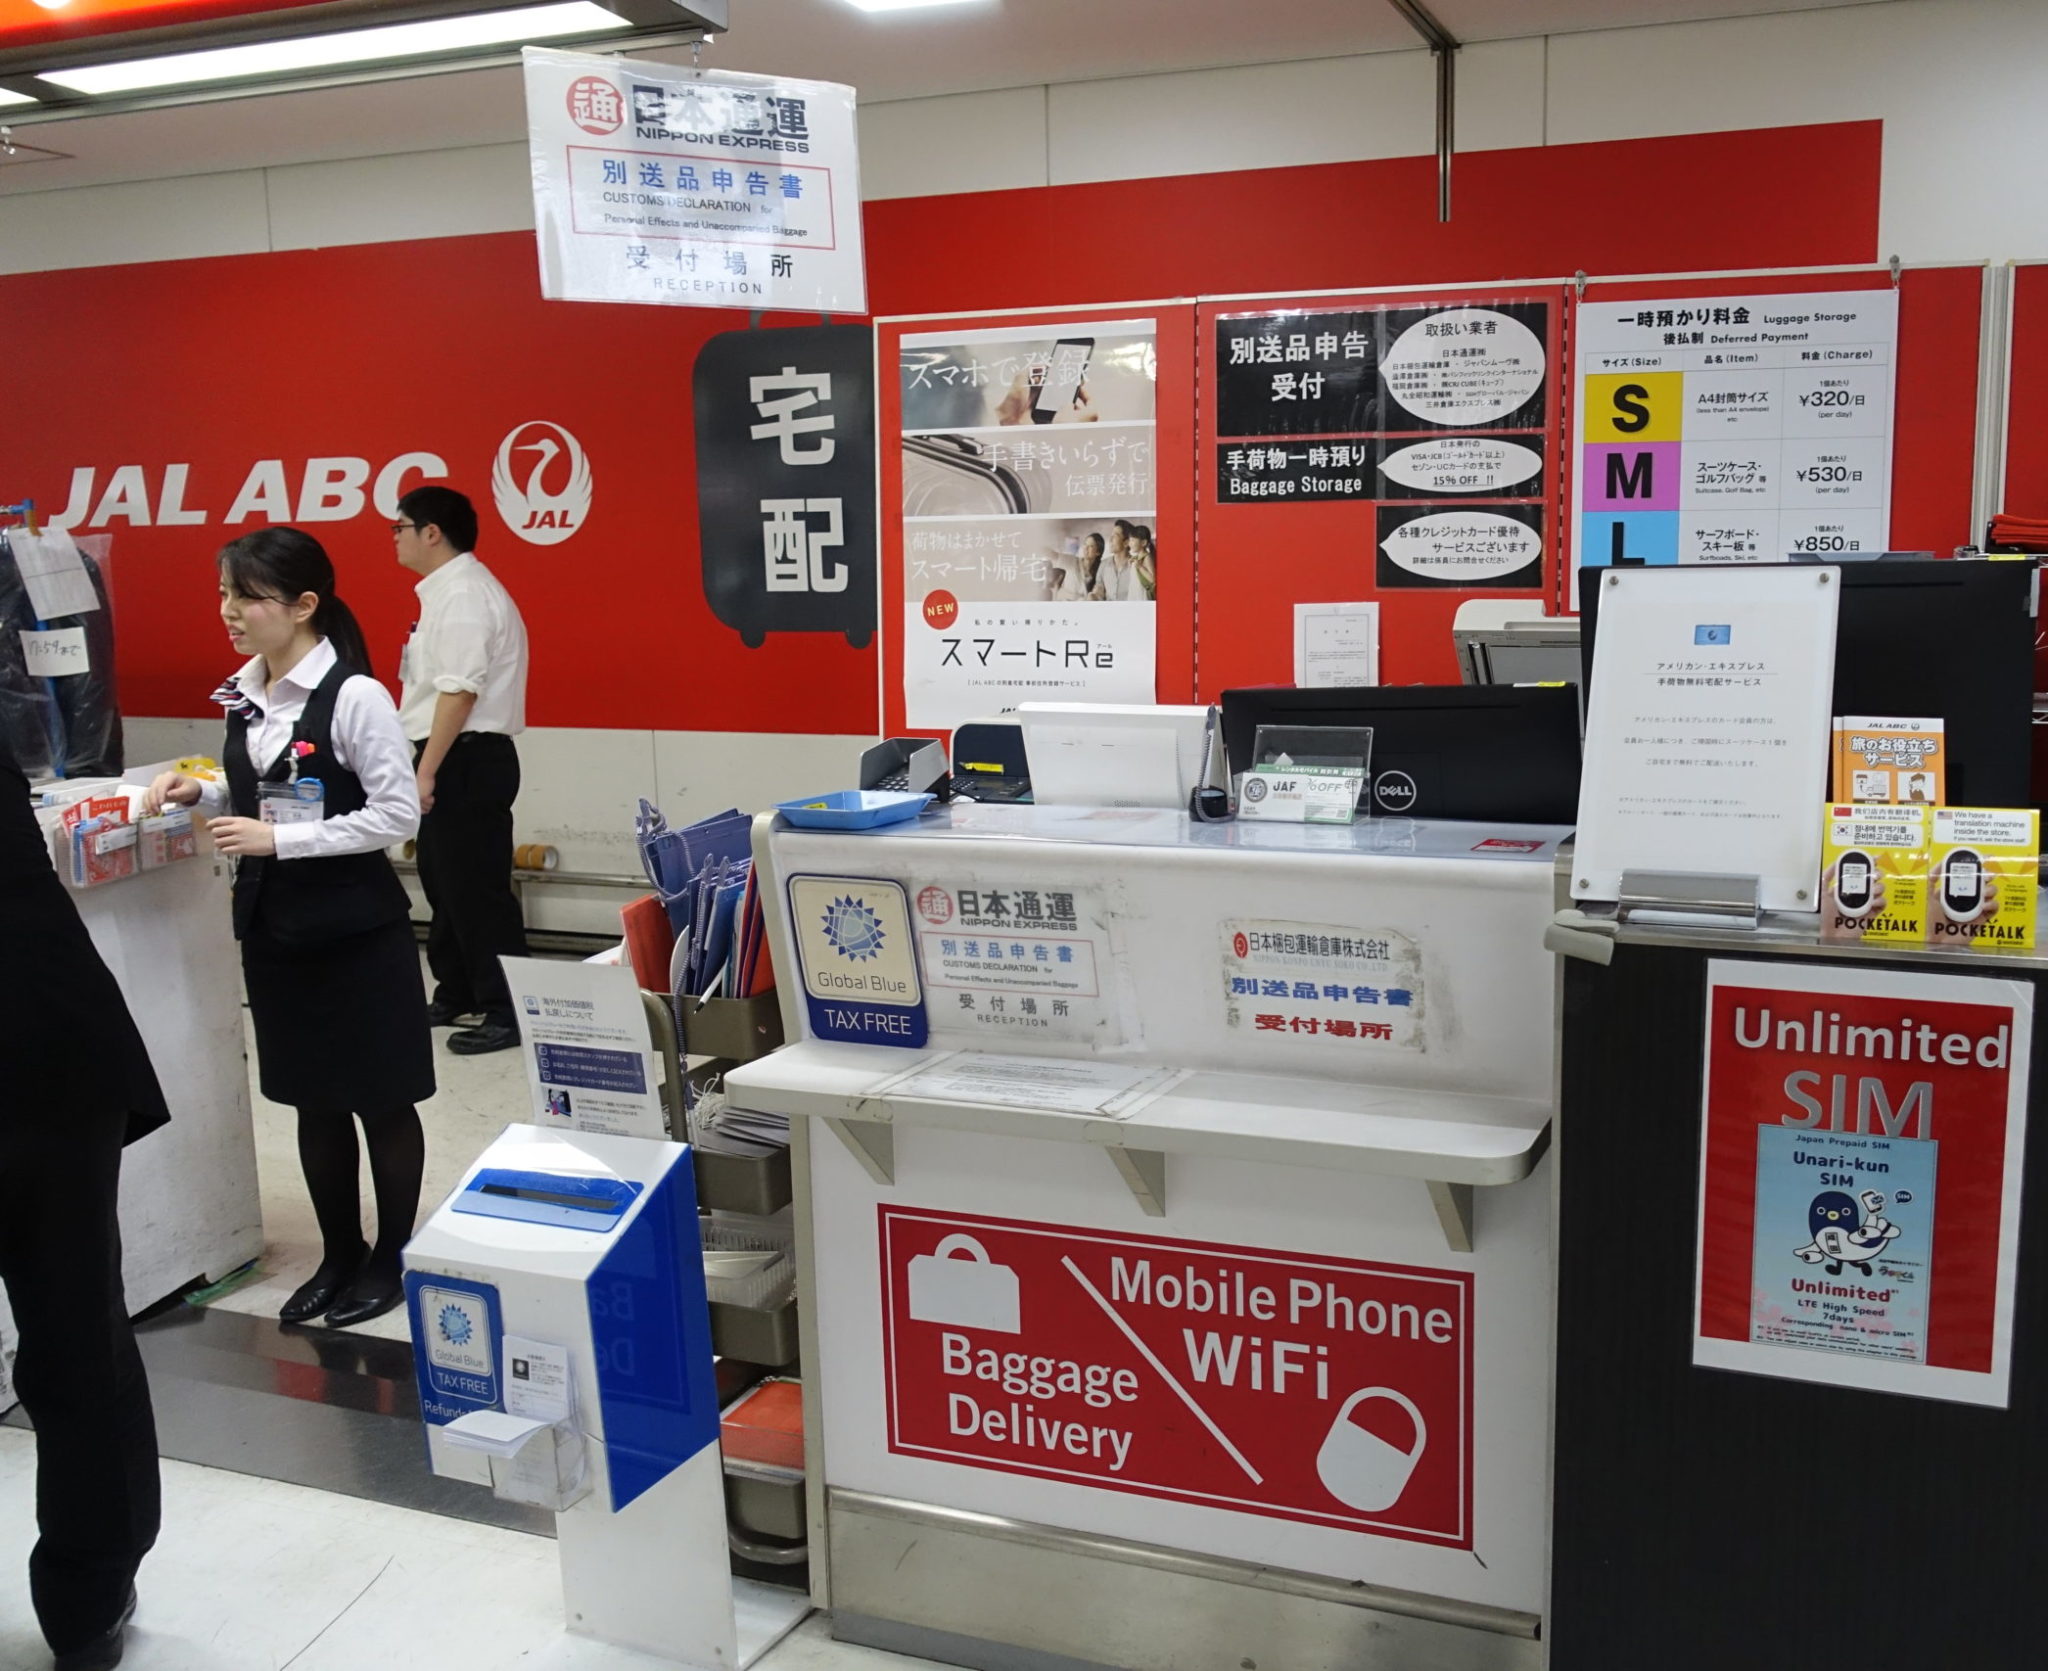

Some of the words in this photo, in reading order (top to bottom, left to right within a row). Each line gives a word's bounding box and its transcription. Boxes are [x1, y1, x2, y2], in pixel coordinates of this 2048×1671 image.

[637, 126, 713, 146] NIPPON
[718, 135, 809, 153] EXPRESS
[602, 159, 803, 199] 別送品申告書
[603, 191, 664, 207] CUSTOMS
[667, 196, 751, 213] DECLARATION
[761, 205, 772, 214] for
[604, 214, 645, 227] Personal
[648, 217, 681, 228] Effects
[683, 219, 699, 229] and
[702, 221, 769, 234] Unaccompanied
[772, 225, 808, 237] Baggage
[626, 246, 793, 279] 受付場所
[654, 278, 762, 294] RECEPTION
[1618, 307, 1750, 328] 一時預かり料金
[1764, 312, 1810, 324] Luggage
[1814, 311, 1856, 322] Storage
[1425, 320, 1498, 337] 取扱い業者
[1663, 331, 1703, 346] 後払制
[1711, 333, 1757, 344] Deferred
[1761, 332, 1808, 343] Payment
[1230, 331, 1368, 365] 別送品申告
[1801, 349, 1873, 362] 料金(Charge)
[908, 351, 1091, 389] スマホで登録
[1602, 356, 1662, 368] サイズ(Size)
[1271, 372, 1325, 401] 受付
[1698, 391, 1768, 404] A4封筒サイズ
[1611, 384, 1650, 433] S
[1818, 411, 1833, 419] (per
[1835, 410, 1852, 418] day)
[981, 436, 1150, 472] 手書きいらずで
[1226, 445, 1366, 470] 手荷物一時預り
[749, 366, 848, 592] 宅配
[1065, 472, 1149, 497] 伝票発行
[1230, 478, 1295, 495] Baggage
[1302, 476, 1362, 493] Storage
[1433, 475, 1457, 486] 15%
[1459, 475, 1478, 485] OFF
[1606, 452, 1653, 499] M
[1696, 472, 1754, 485] ゴルフバッグ
[48, 463, 208, 529] JAL
[224, 451, 449, 525] ABC
[1815, 486, 1831, 494] (per
[1833, 486, 1850, 494] day)
[522, 509, 575, 529] JAL
[912, 531, 1023, 550] 荷物はまかせて
[1398, 526, 1520, 539] 各種クレジットカード優待
[1432, 542, 1530, 553] サービスございます
[1612, 522, 1645, 565] L
[1702, 541, 1744, 552] スキー板
[912, 554, 1048, 583] スマート帰宅
[927, 603, 955, 617] NEW
[941, 639, 1113, 668] スマートRe
[1657, 678, 1762, 687] 手荷物無料宅配サービス
[1851, 737, 1937, 752] 旅のお役立ち
[1865, 752, 1924, 768] サービス
[1273, 781, 1297, 792] JAF
[1379, 785, 1412, 796] DELL
[1954, 828, 1976, 836] inside
[1955, 819, 1992, 827] translation
[957, 889, 1077, 922] 日本通運
[961, 918, 1011, 928] NIPPON
[1013, 920, 1078, 931] EXPRESS
[1835, 917, 1918, 932] POCKETALK
[1935, 923, 2025, 939] POCKETALK
[941, 939, 1073, 963] 別送品申告書
[1249, 932, 1390, 960] 日本梱包運輸倉庫株式会社
[943, 960, 981, 970] CUSTOMS
[983, 961, 1038, 973] DECLARATION
[818, 970, 868, 990] Global
[871, 976, 906, 994] Blue
[1232, 977, 1414, 1007] 別送品申告書
[959, 993, 1069, 1016] 受付場所
[824, 1008, 862, 1030] TAX
[864, 1013, 912, 1035] FREE
[977, 1013, 1048, 1027] RECEPTION
[1255, 1014, 1393, 1041] 受付場所
[1733, 1006, 2009, 1069] Unlimited
[1781, 1070, 1934, 1140] SIM
[1796, 1134, 1825, 1144] Japan
[1829, 1137, 1866, 1149] Prepaid
[1872, 1141, 1890, 1149] SIM
[1793, 1151, 1889, 1173] Unari-kun
[1820, 1172, 1854, 1187] SIM
[1110, 1256, 1276, 1321] Mobile
[1289, 1278, 1454, 1344] Phone
[1792, 1278, 1891, 1302] Unlimited
[1798, 1299, 1817, 1309] LTE
[1823, 1302, 1847, 1313] High
[1853, 1305, 1885, 1316] Speed
[1823, 1312, 1854, 1324] 7days
[1781, 1317, 1833, 1329] Corresponding
[435, 1349, 462, 1365] Global
[463, 1354, 484, 1369] Blue
[941, 1331, 1139, 1407] Baggage
[1182, 1328, 1329, 1400] WiFi
[437, 1372, 459, 1388] TAX
[460, 1377, 488, 1395] FREE
[948, 1393, 1133, 1471] Delivery
